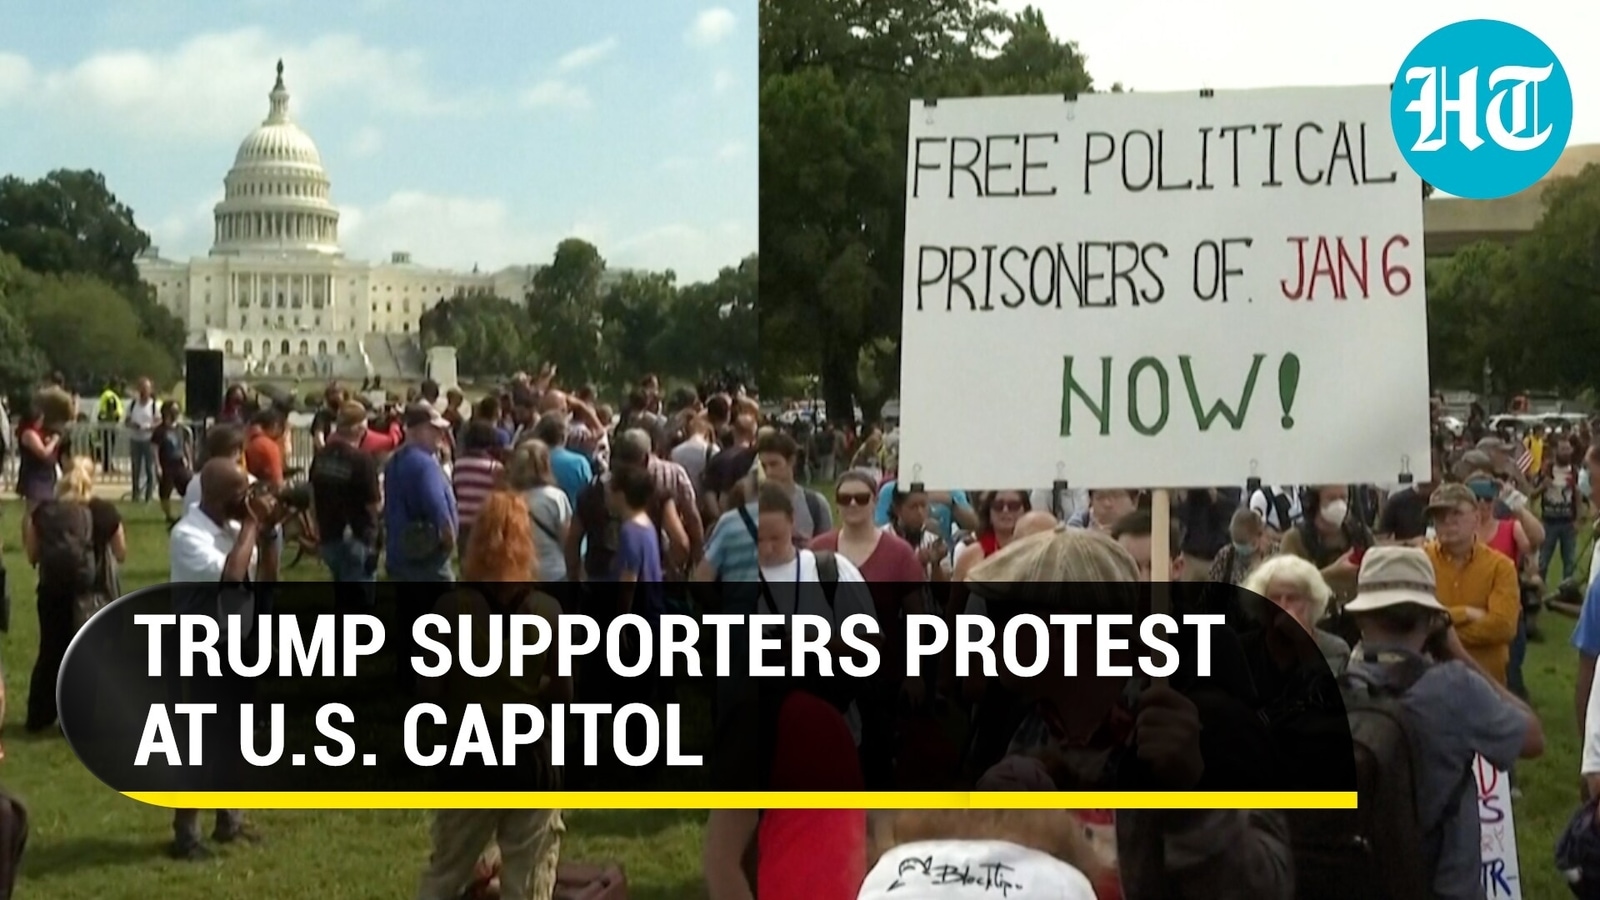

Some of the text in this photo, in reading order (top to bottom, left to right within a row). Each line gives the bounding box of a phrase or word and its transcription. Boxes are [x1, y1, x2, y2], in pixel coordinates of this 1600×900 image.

[912, 121, 1397, 198] FREE POLITICAL
[916, 239, 1169, 311] PRISONERS
[1280, 235, 1370, 300] JAN
[1381, 234, 1412, 297] 6
[1059, 351, 1301, 437] NOW!
